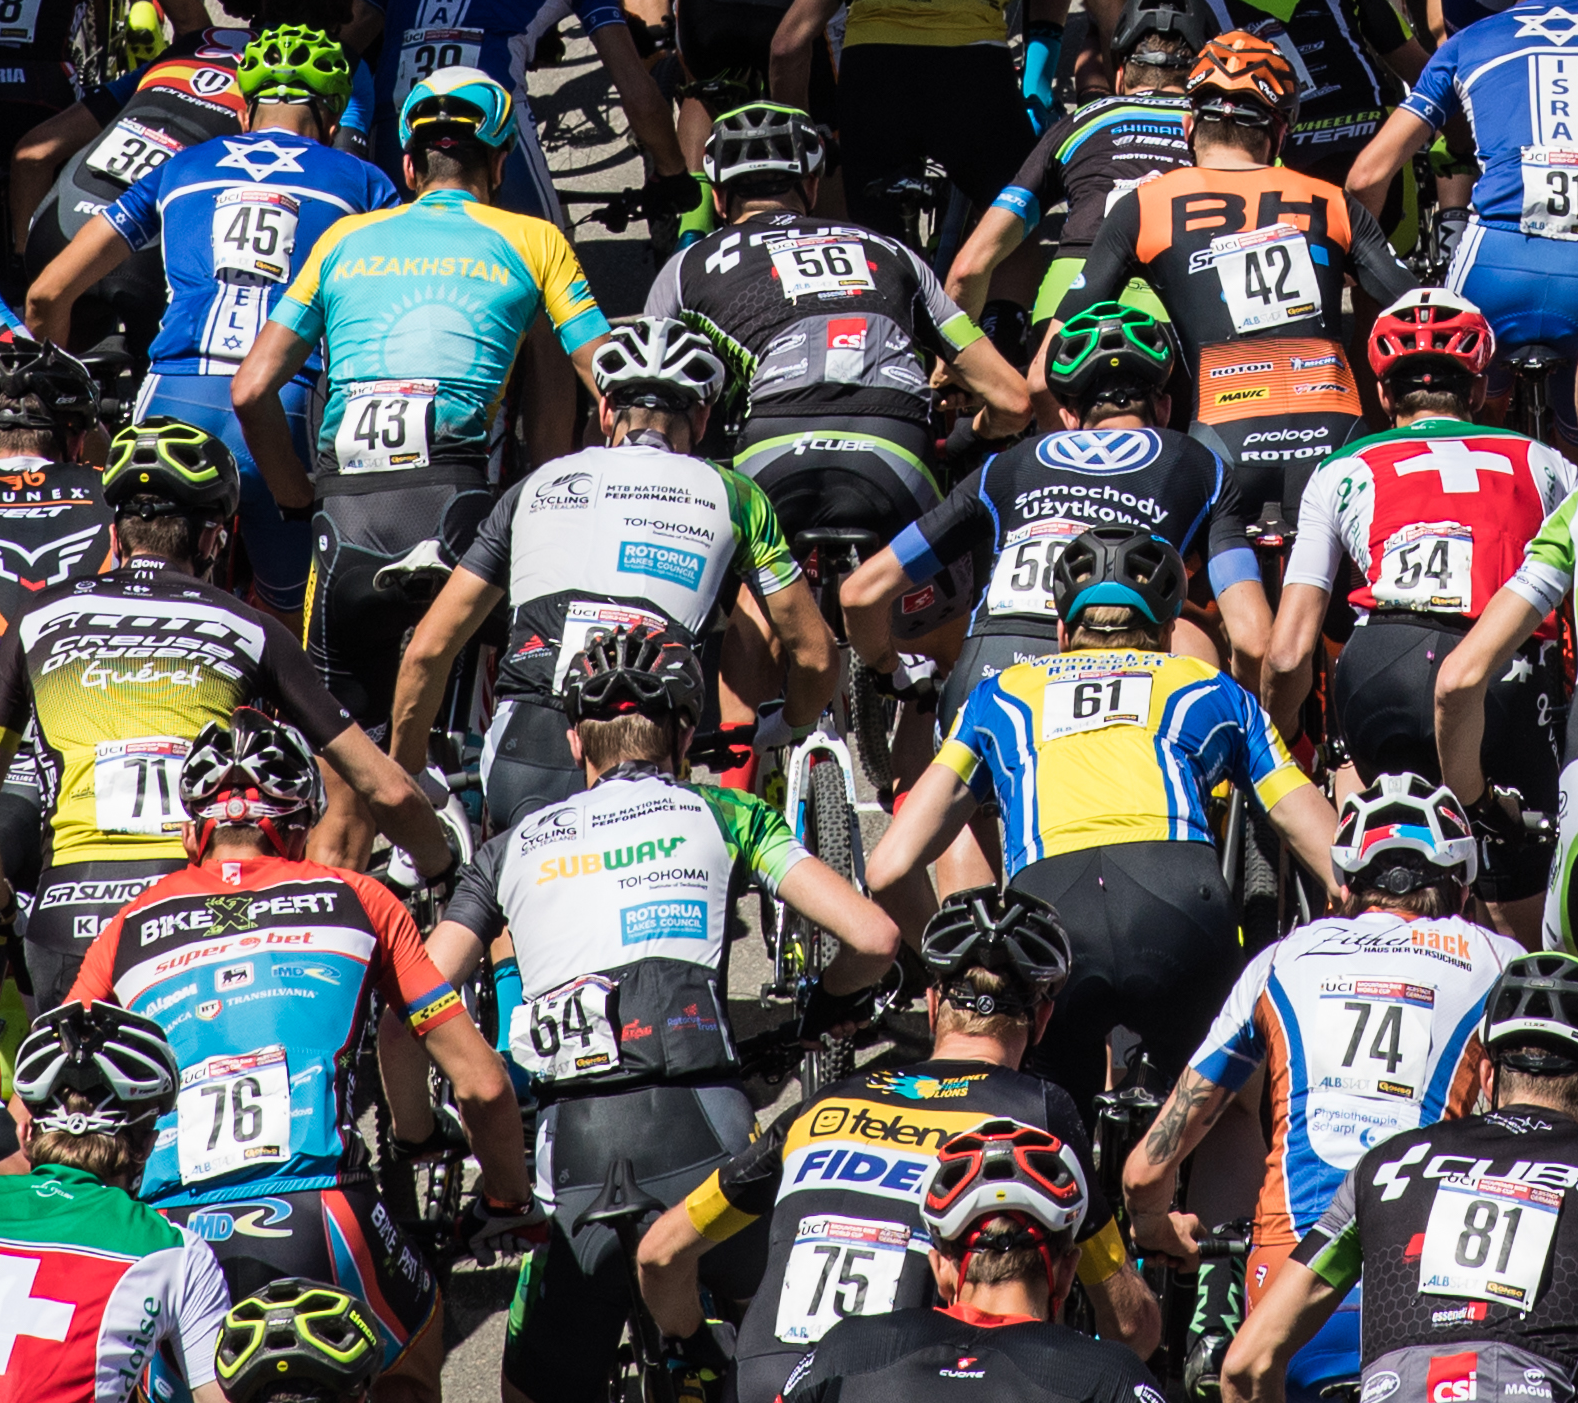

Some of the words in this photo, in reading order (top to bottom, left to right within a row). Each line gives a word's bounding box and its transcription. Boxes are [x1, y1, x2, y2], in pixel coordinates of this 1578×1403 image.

[223, 206, 280, 256] 45
[333, 256, 510, 287] KAZAKHSTAN
[797, 246, 851, 276] 56
[1244, 243, 1298, 306] 42
[1218, 388, 1266, 404] MAVIC
[353, 400, 407, 450] 43
[1240, 444, 1332, 461] ROTOR
[624, 557, 653, 567] LAKES
[657, 562, 696, 580] COUNCIL
[625, 545, 699, 571] ROTORUA
[1074, 678, 1121, 719] 61
[536, 836, 687, 885] SUBWAY
[618, 869, 709, 889] TOI-OHOMAI
[1343, 1003, 1403, 1074] 74
[1453, 1200, 1522, 1275] 81
